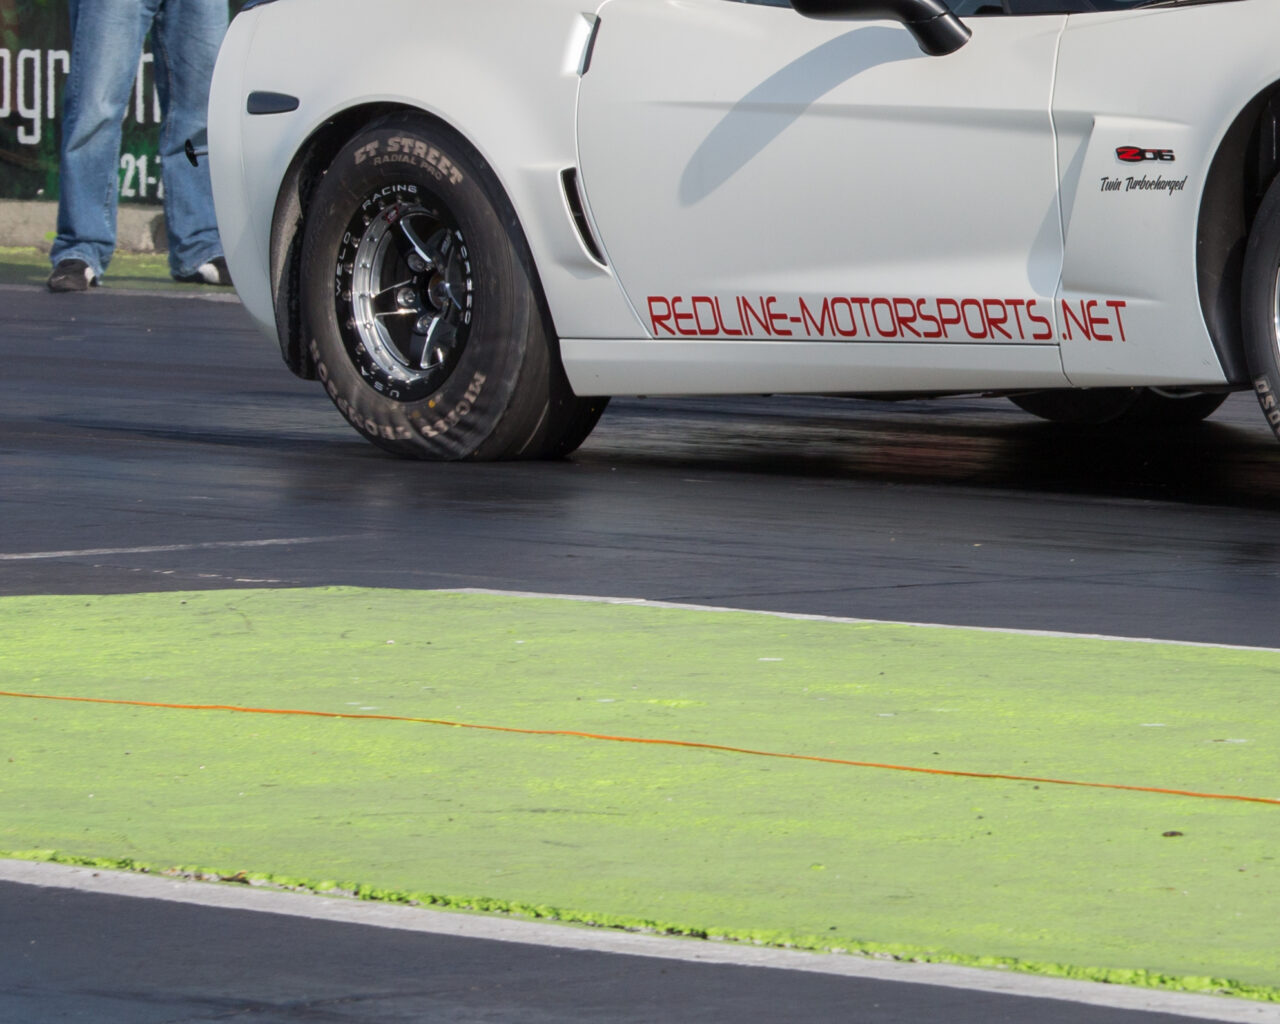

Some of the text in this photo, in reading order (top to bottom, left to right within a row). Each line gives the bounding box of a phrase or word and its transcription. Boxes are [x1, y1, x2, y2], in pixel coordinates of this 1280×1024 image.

[354, 137, 463, 185] ET STREET
[374, 154, 416, 166] RADIAL
[1100, 174, 1188, 196] Twin Turbocharged
[336, 184, 418, 296] WELD RACING
